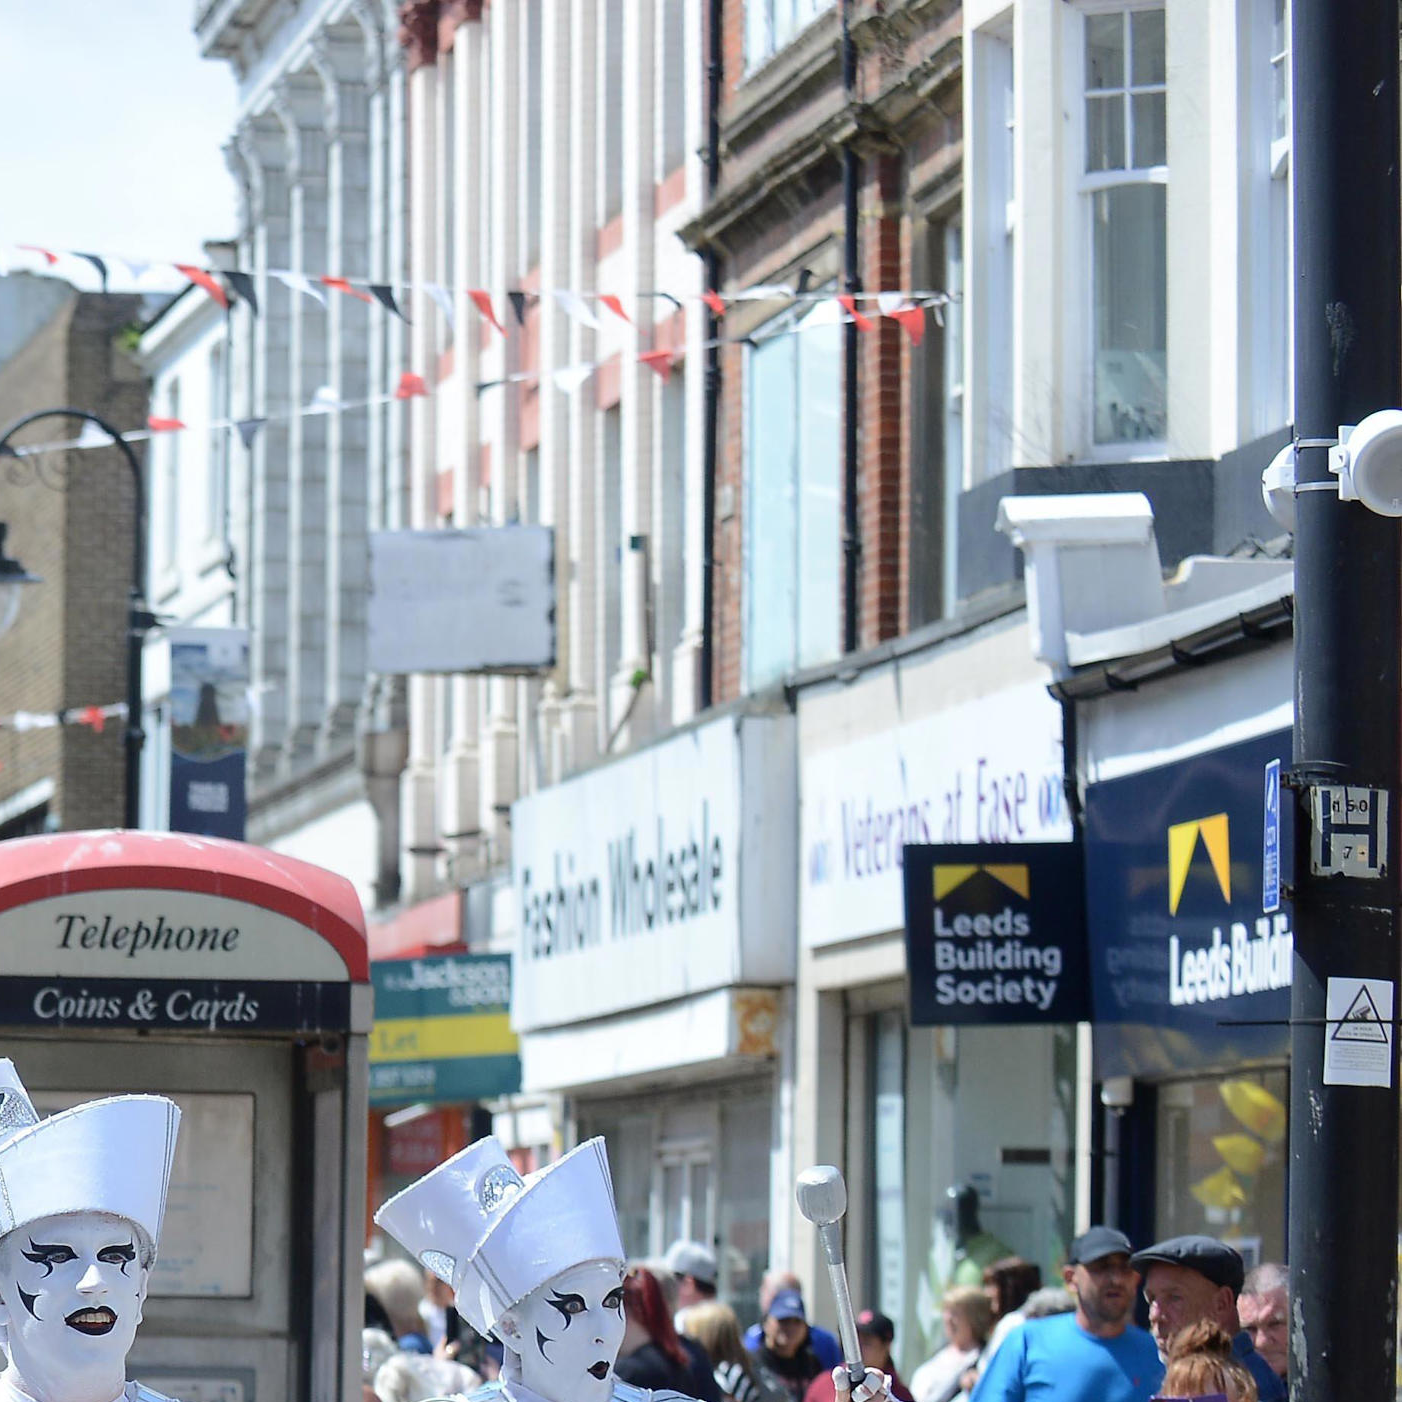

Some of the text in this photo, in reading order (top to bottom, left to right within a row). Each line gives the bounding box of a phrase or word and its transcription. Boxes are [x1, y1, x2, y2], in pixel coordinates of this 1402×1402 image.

[841, 757, 1028, 879] Veterans at Ease
[520, 797, 722, 963] Fashion Wholesale
[56, 914, 240, 958] Telephone
[933, 907, 1031, 937] Leeds
[934, 939, 1062, 976] Building
[1169, 926, 1231, 1006] Leeds
[1231, 913, 1294, 997] Buildin
[33, 986, 260, 1023] Coins & Cards
[935, 974, 1057, 1010] Society
